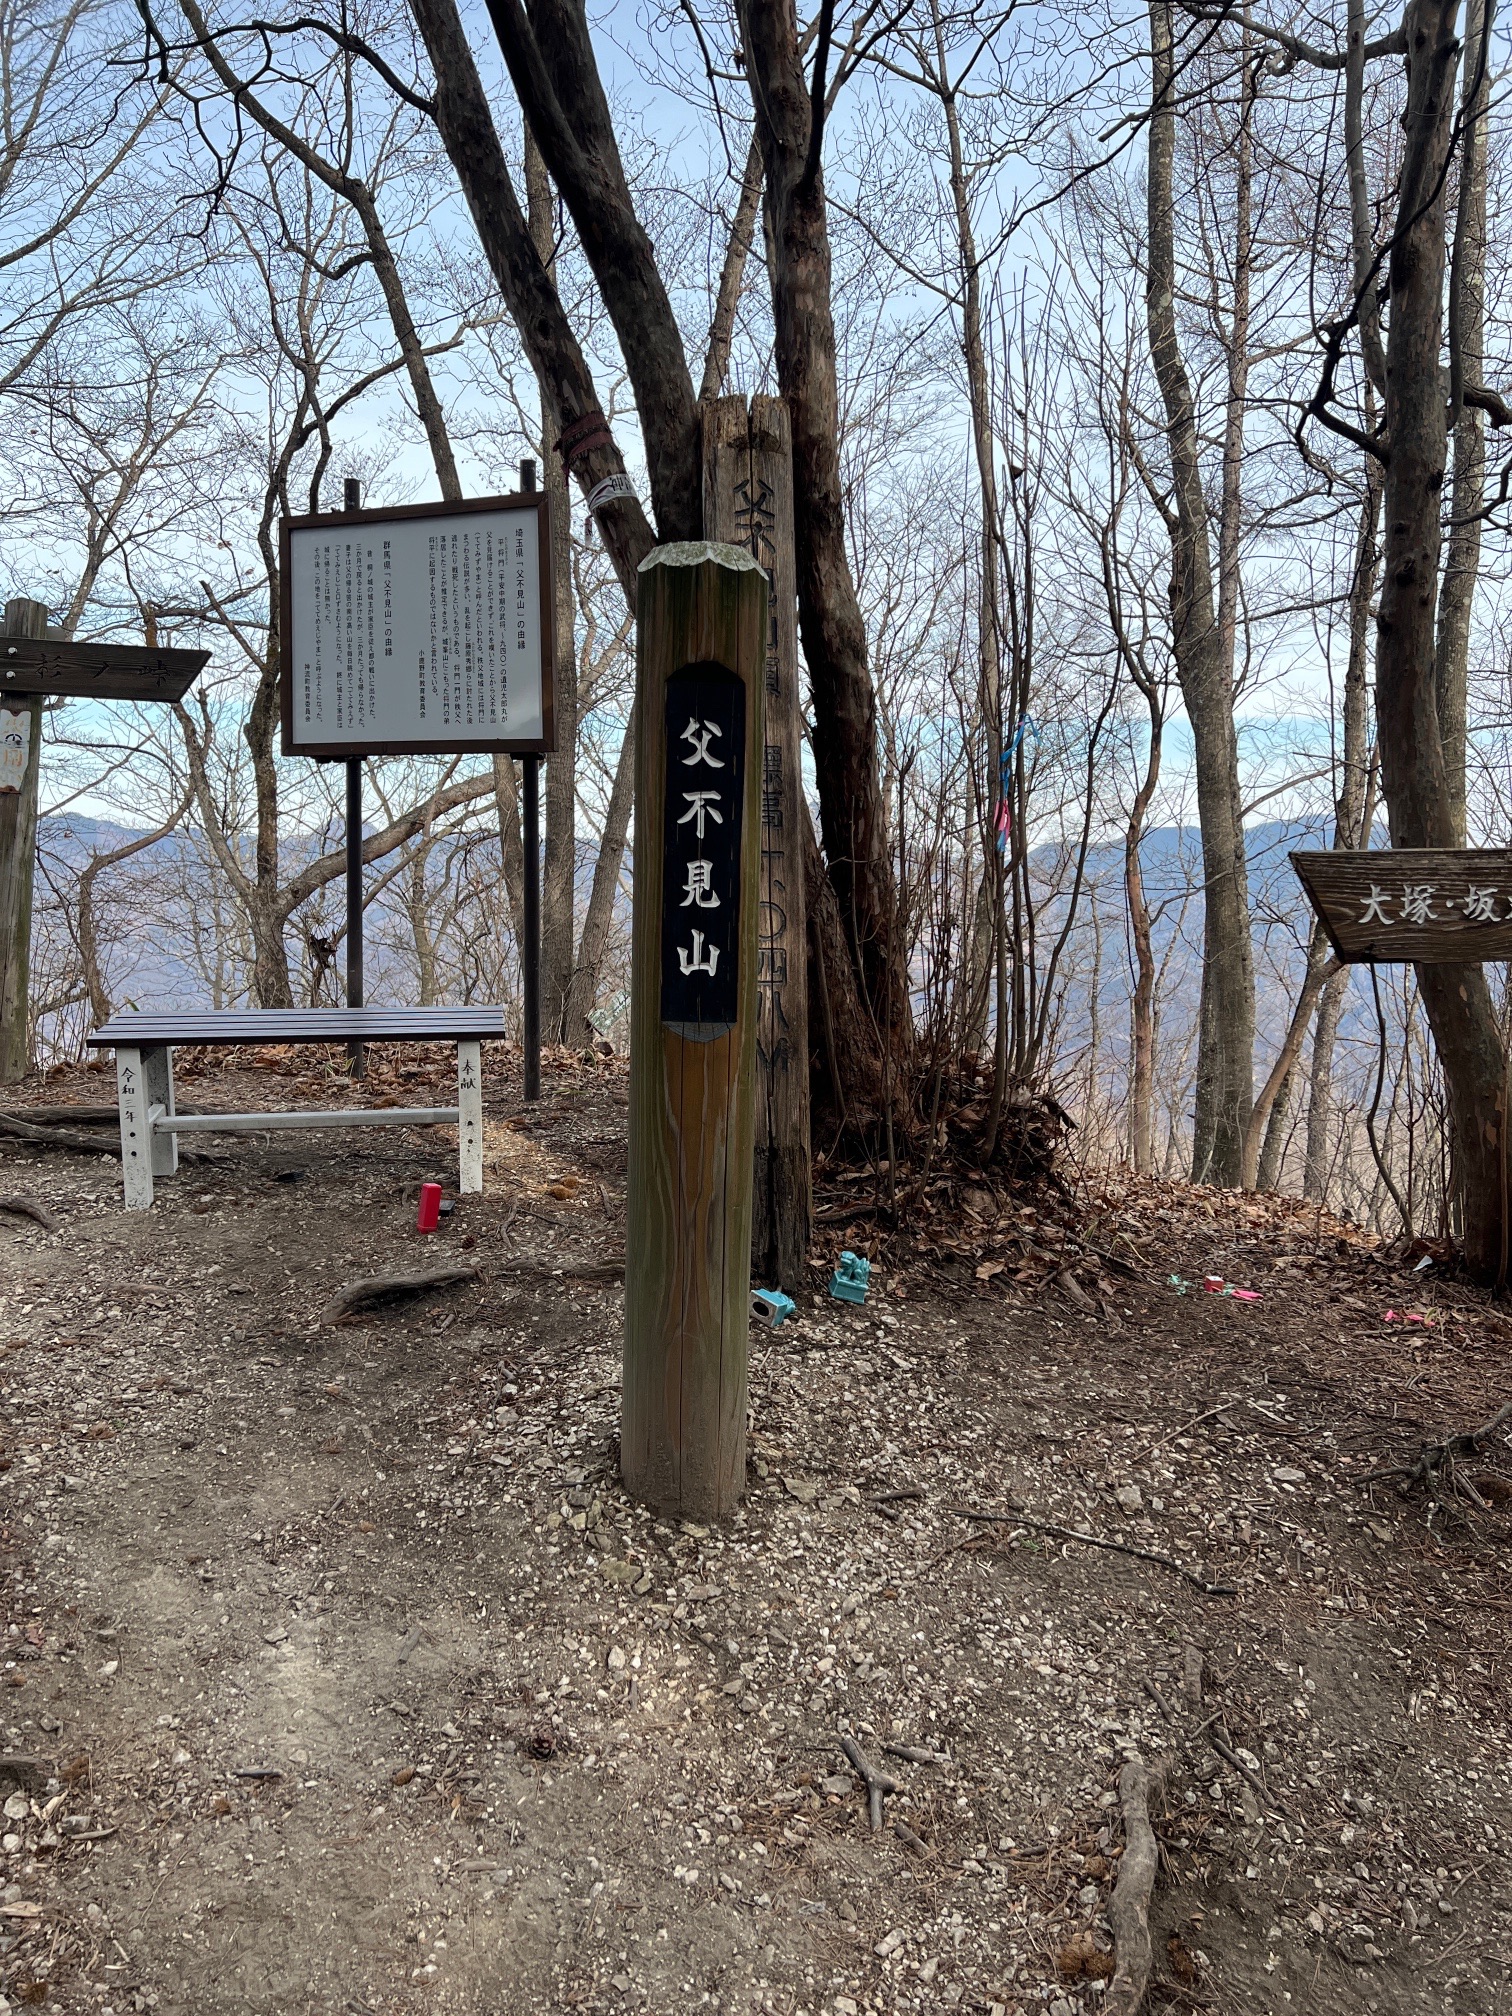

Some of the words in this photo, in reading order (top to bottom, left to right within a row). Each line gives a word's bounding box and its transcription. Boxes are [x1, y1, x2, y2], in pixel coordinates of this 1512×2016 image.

[383, 541, 393, 657] 群馬県「父不見山」の由縁
[515, 528, 526, 650] 埼玉県「父不見山」の由縁
[418, 650, 426, 719] 小鹿野町教育委員会
[677, 717, 725, 977] 父不見山
[1358, 884, 1512, 925] 大塚・坂
[121, 1067, 137, 1122] 令和三年
[460, 1059, 477, 1089] 奉献
